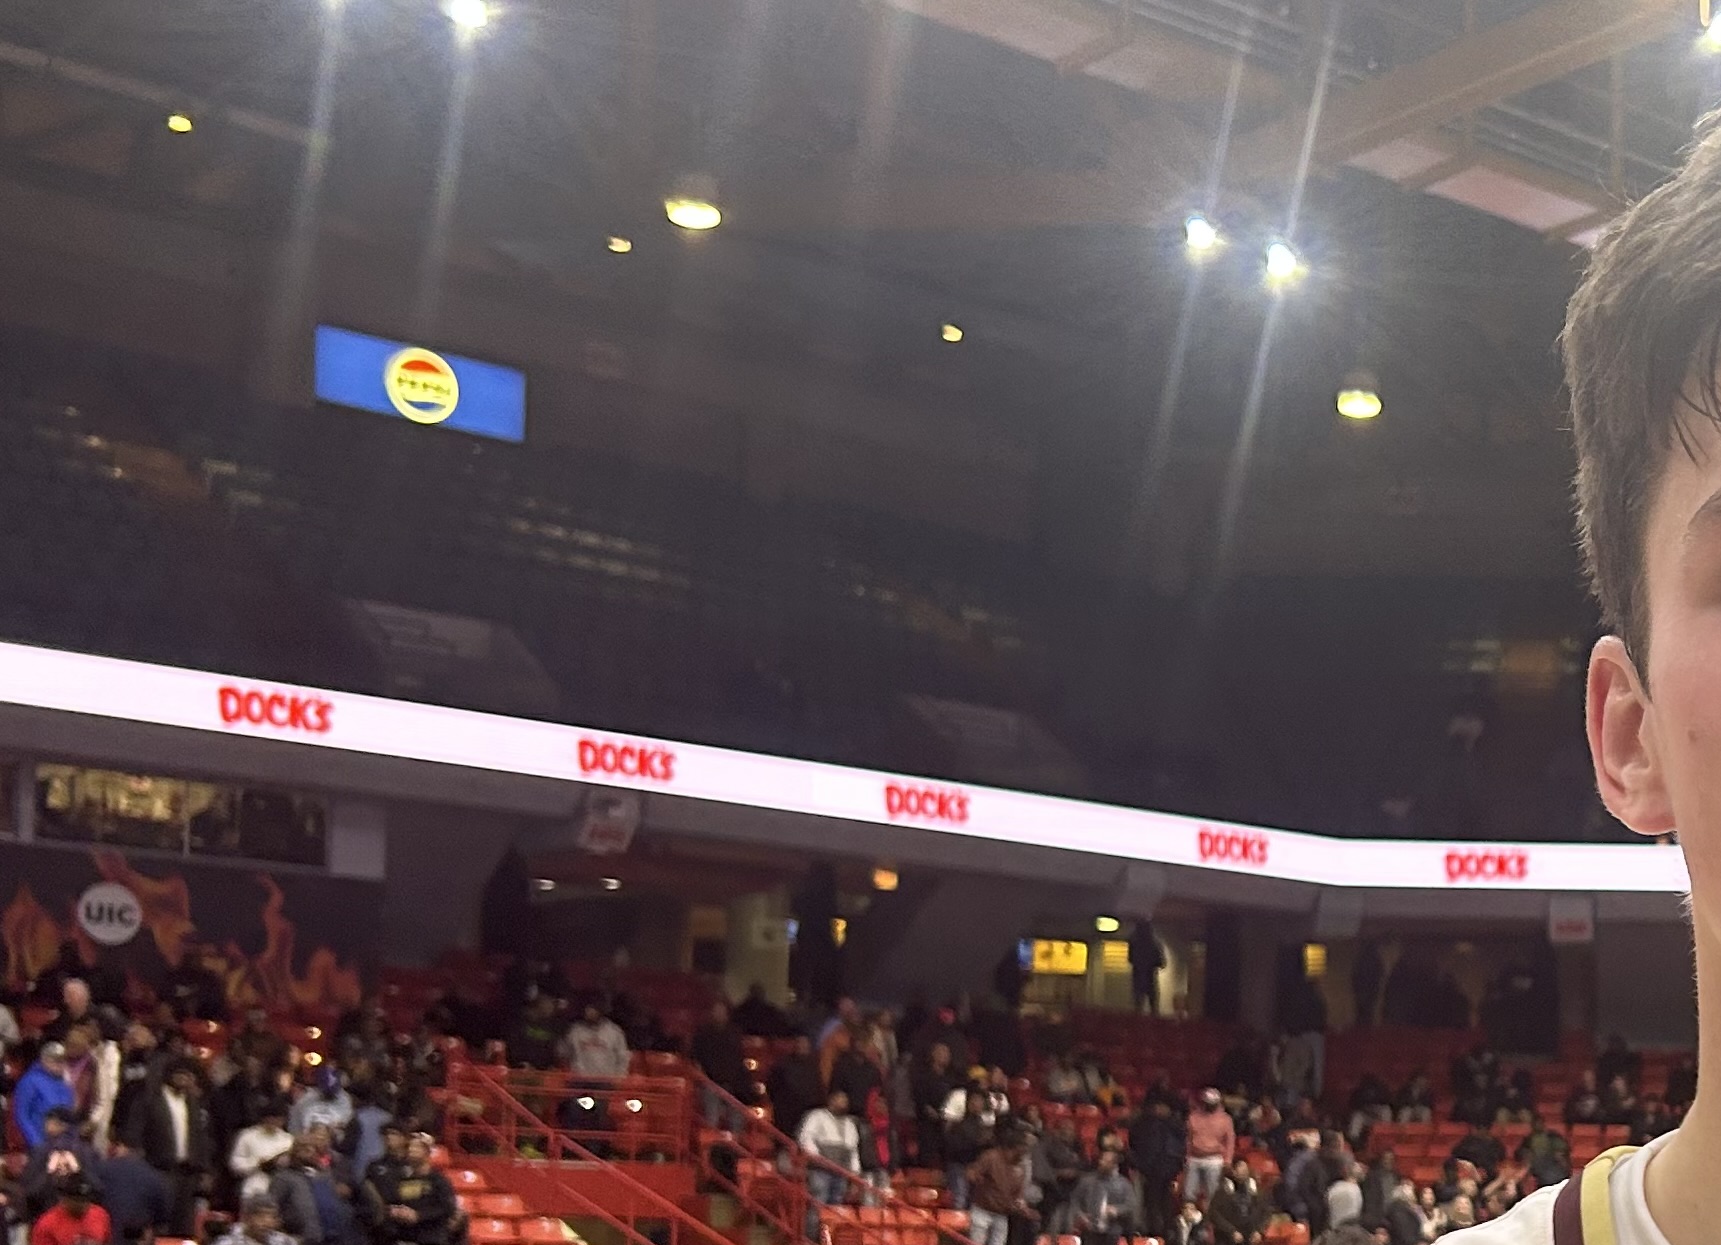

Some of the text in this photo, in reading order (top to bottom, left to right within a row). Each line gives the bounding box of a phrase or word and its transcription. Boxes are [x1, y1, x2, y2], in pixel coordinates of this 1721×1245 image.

[218, 686, 334, 733] DOCK'S
[577, 739, 677, 781] DOCK'S
[885, 783, 971, 825] DOCK'S
[1198, 829, 1269, 865] DOCK'S
[1444, 849, 1528, 883] DOCK'S
[84, 901, 135, 928] UIC
